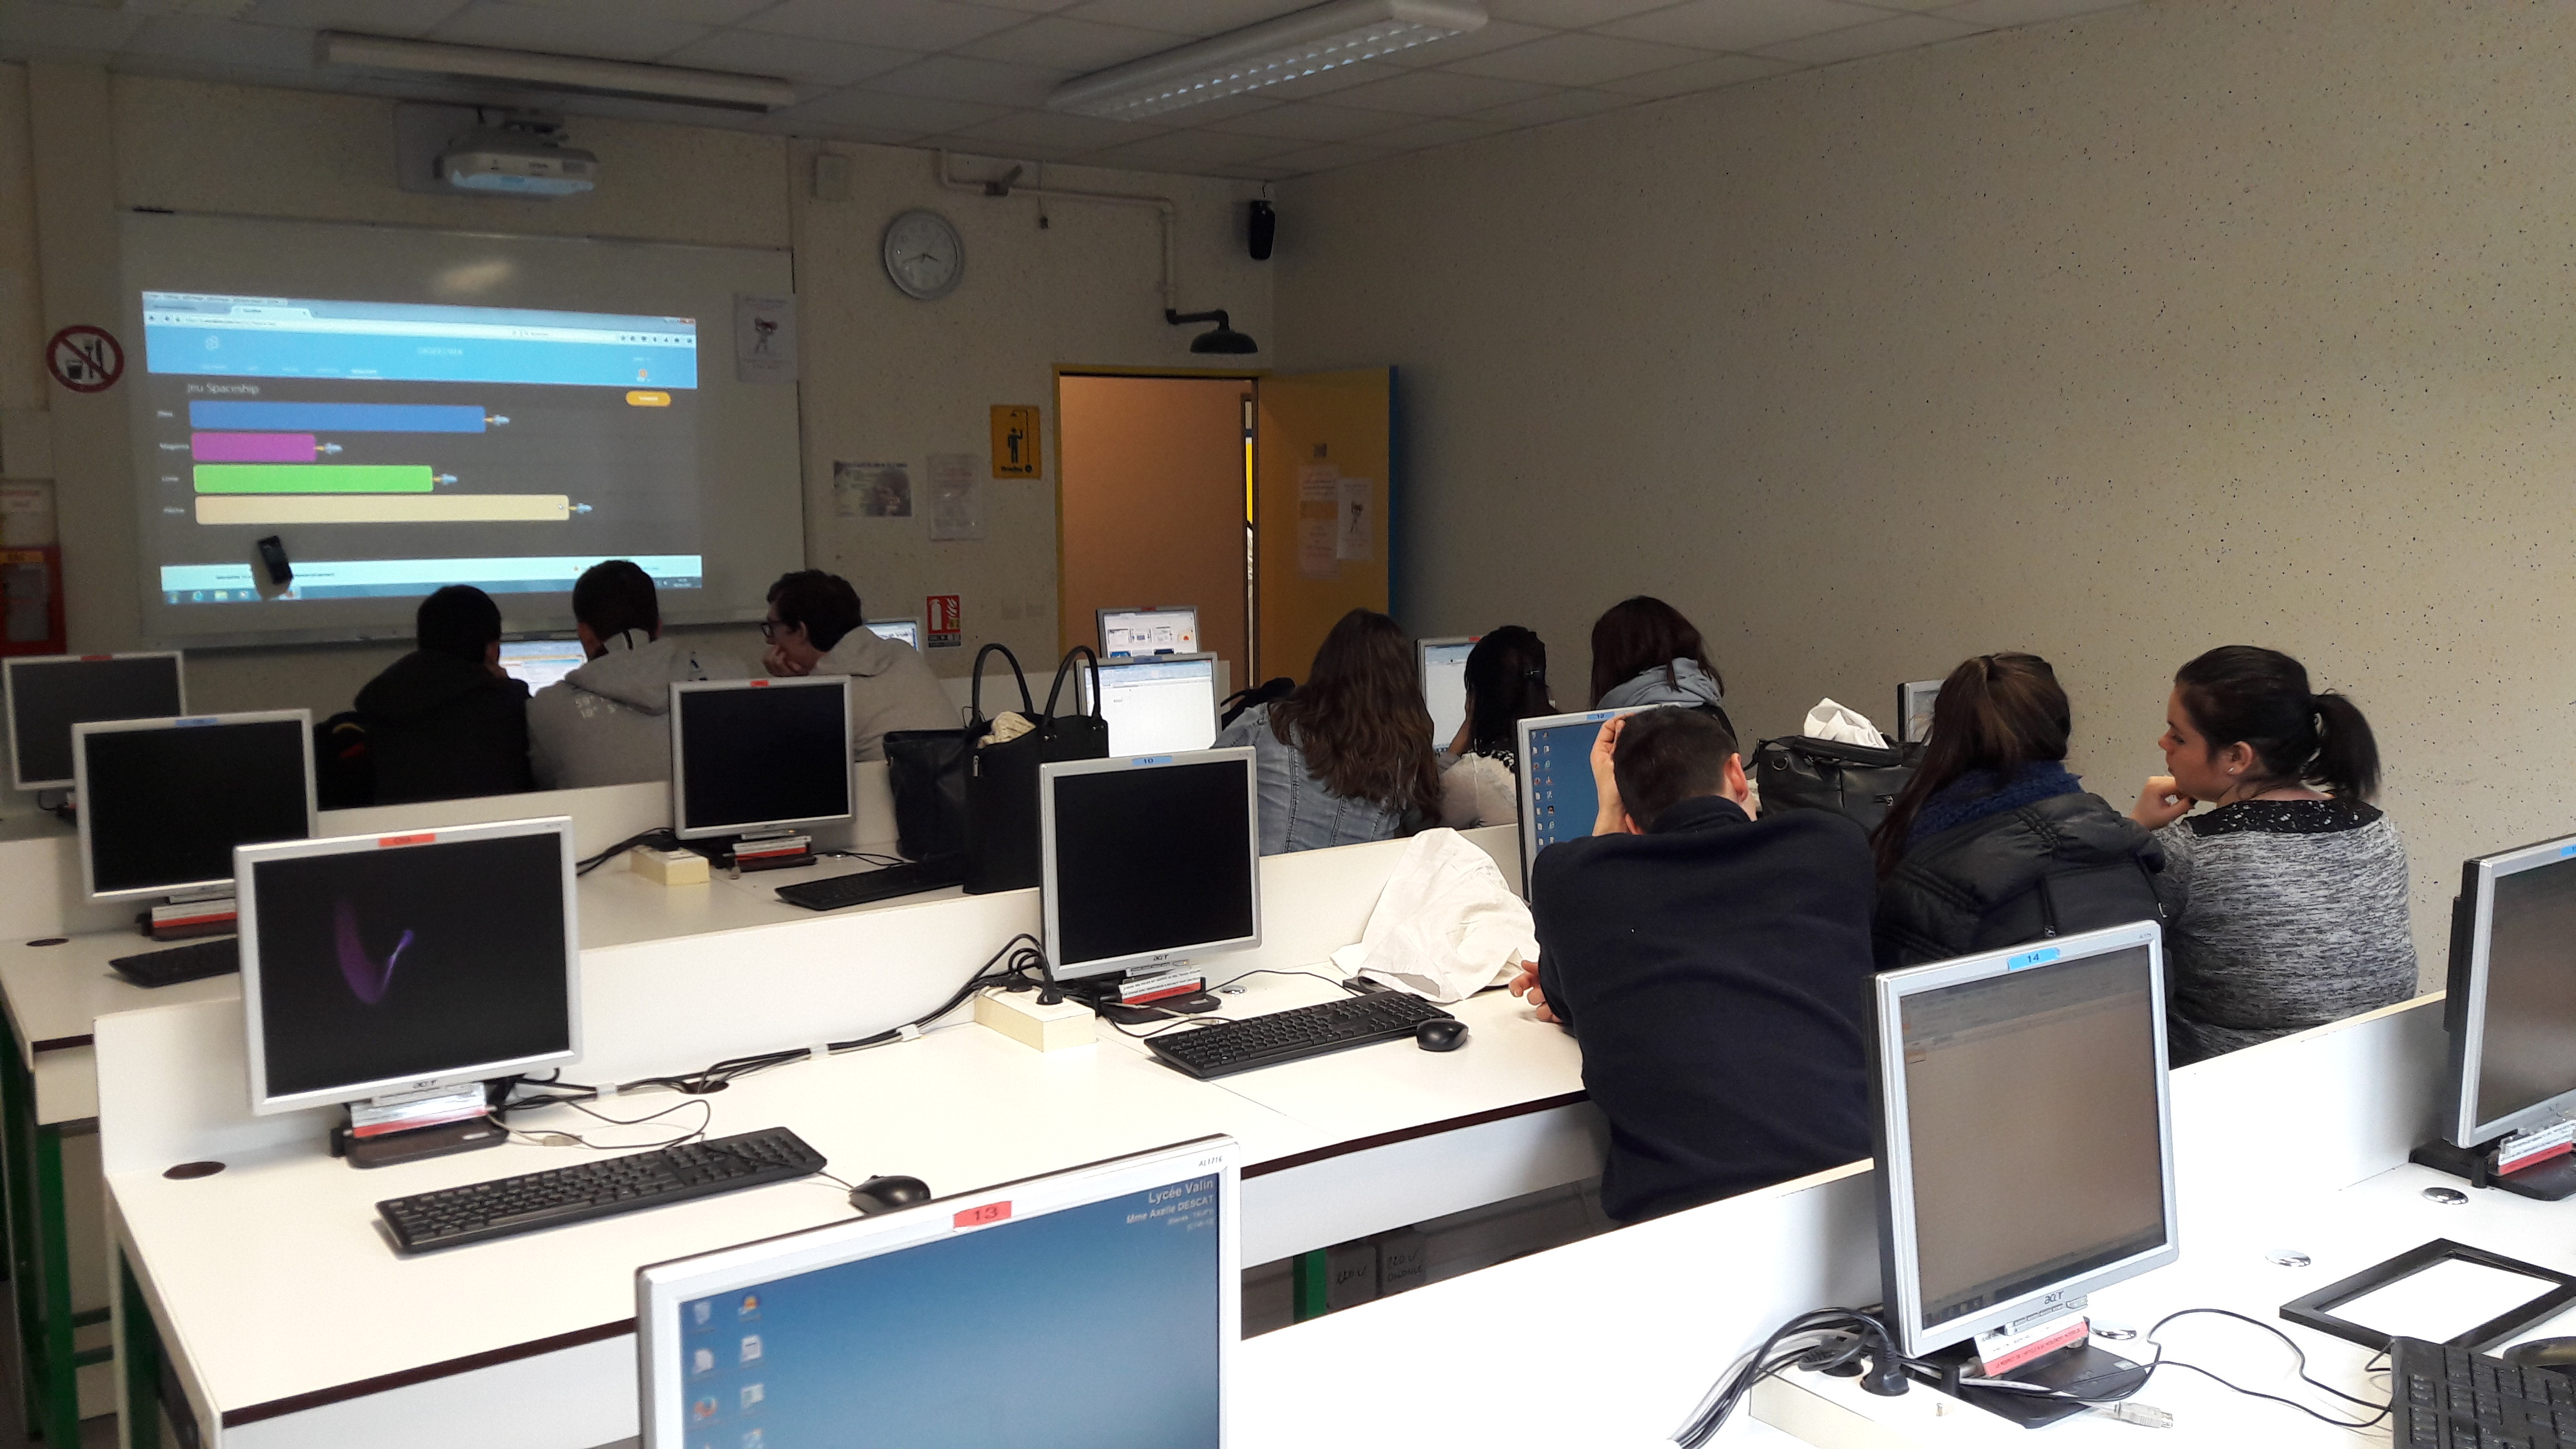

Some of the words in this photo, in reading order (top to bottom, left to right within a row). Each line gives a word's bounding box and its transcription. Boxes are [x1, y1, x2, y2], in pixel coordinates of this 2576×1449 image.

[207, 383, 260, 396] Spaceship
[2027, 953, 2039, 963] 14
[1149, 1186, 1183, 1204] Lycée
[1186, 1179, 1214, 1194] Valin
[975, 1206, 998, 1221] 13
